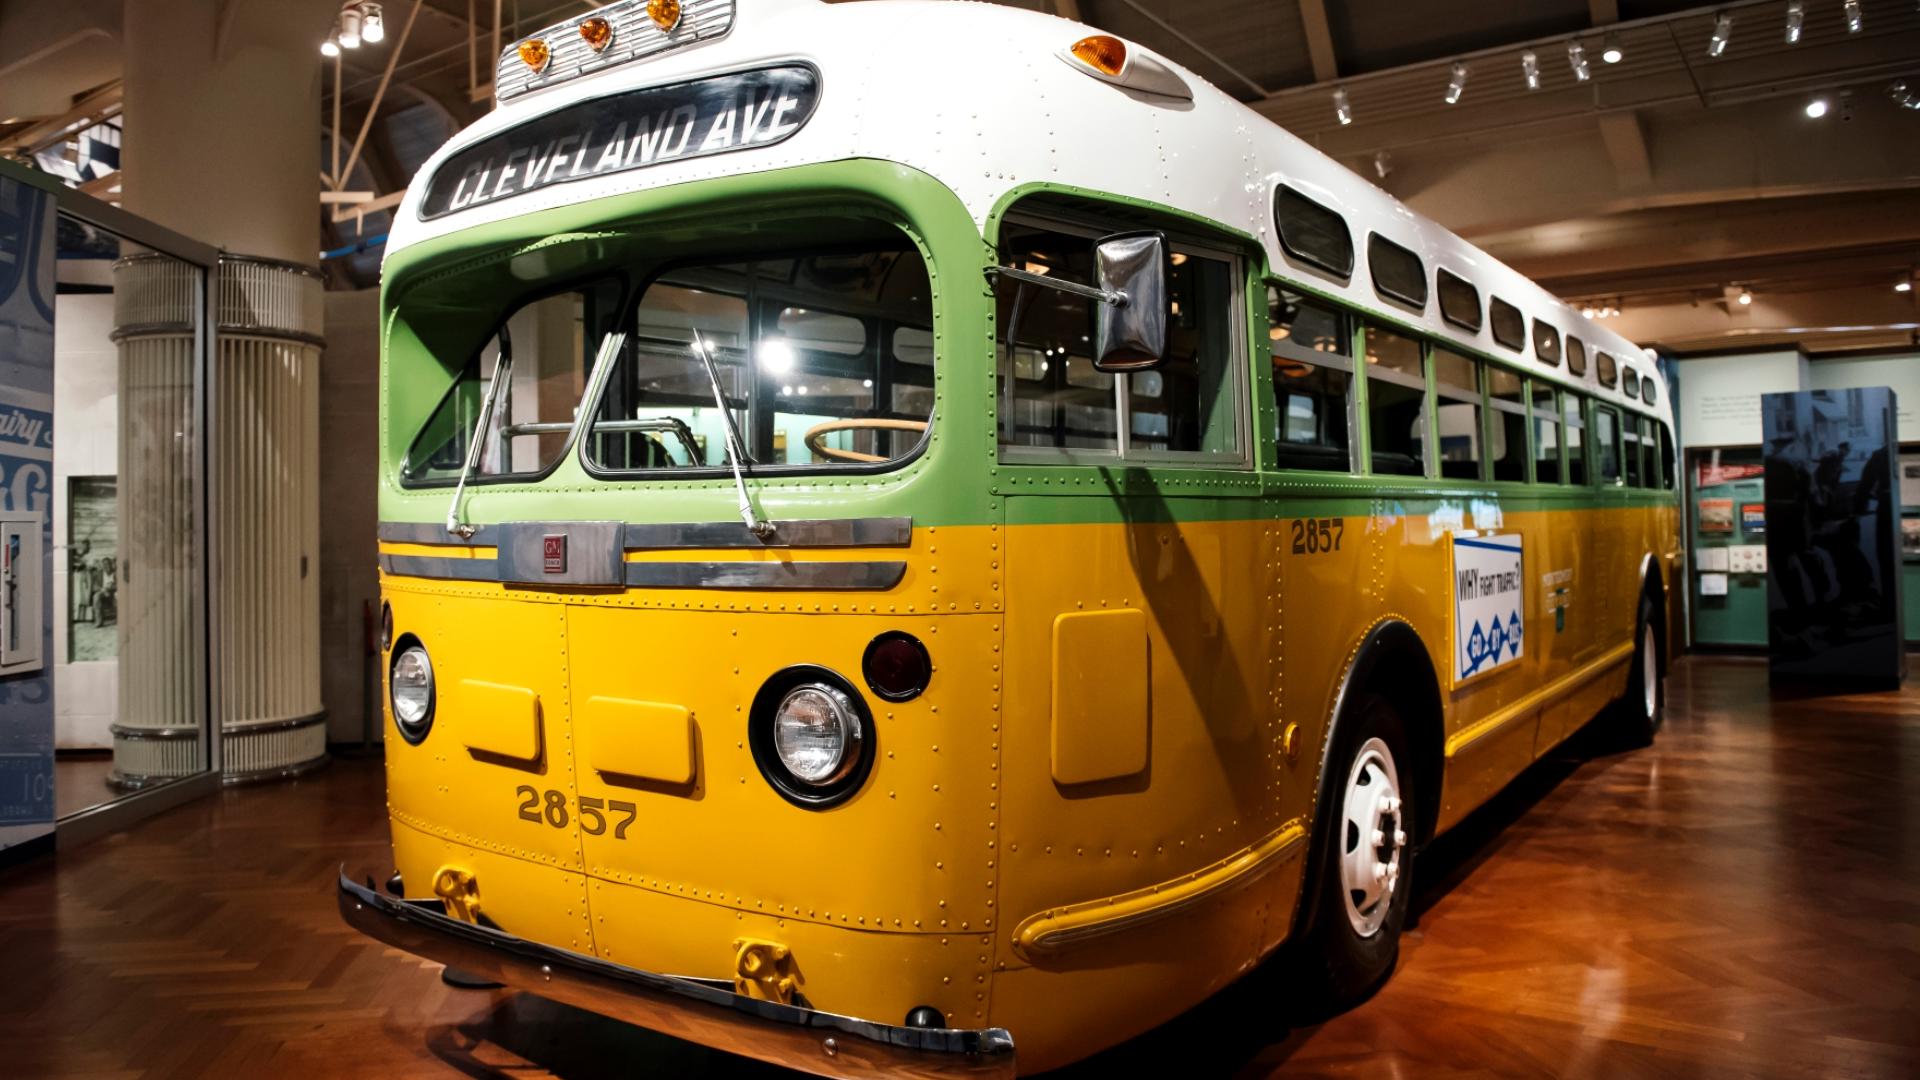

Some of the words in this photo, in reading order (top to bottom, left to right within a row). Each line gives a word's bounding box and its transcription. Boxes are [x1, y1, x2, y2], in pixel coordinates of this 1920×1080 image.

[448, 103, 697, 211] CLEVELAND
[698, 88, 800, 152] AVE
[1291, 517, 1344, 555] 2857
[1458, 568, 1479, 601] WHY
[1479, 575, 1496, 597] FIGHT
[1471, 633, 1482, 658] GO
[516, 784, 637, 840] 2857
